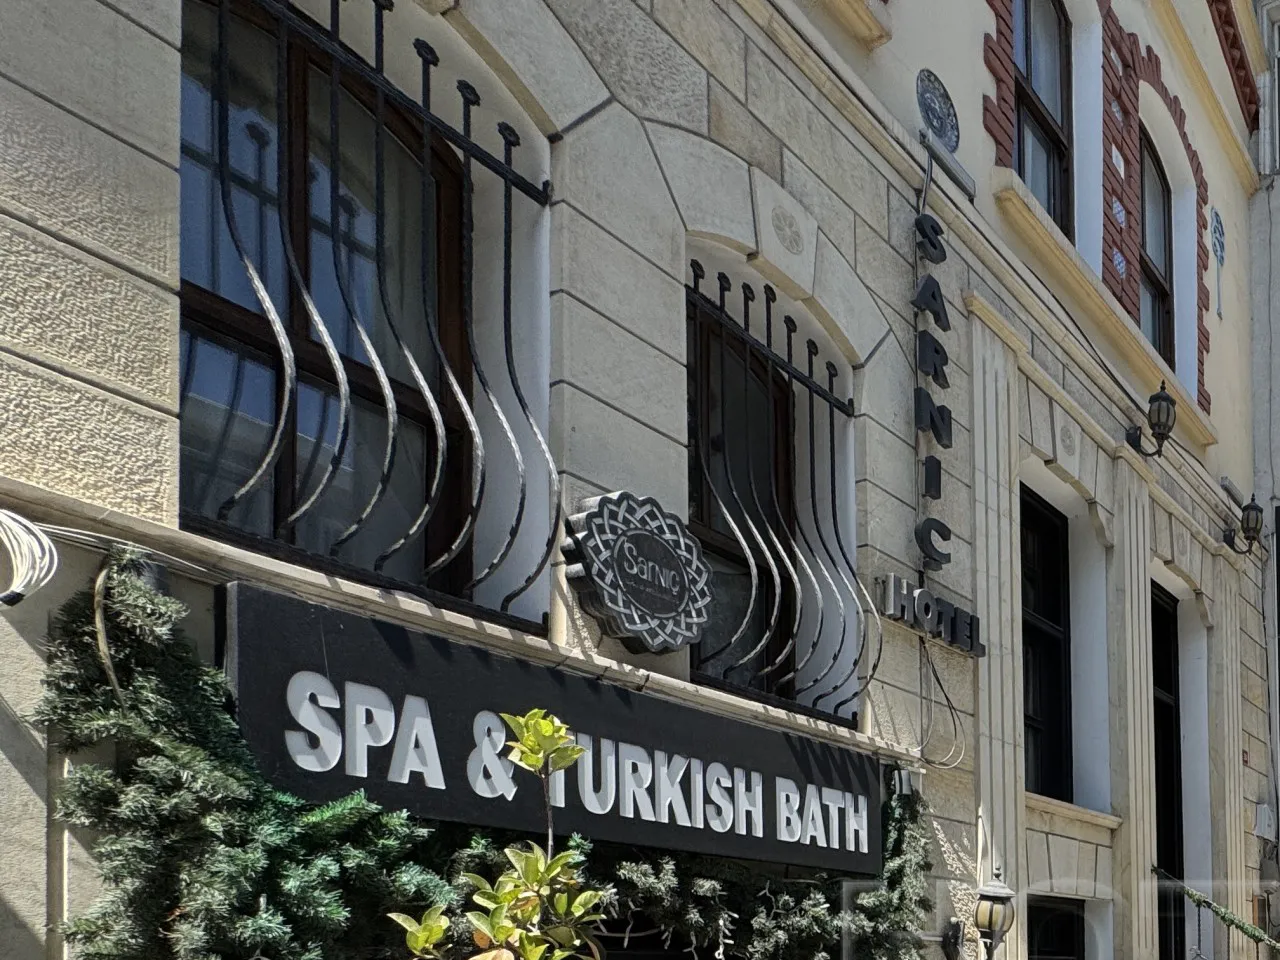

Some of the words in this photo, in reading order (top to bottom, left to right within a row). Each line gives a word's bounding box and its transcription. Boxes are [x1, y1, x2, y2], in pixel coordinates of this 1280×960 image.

[884, 572, 986, 658] HOTEL
[284, 671, 446, 790] SPA
[466, 709, 518, 802] &
[776, 777, 869, 854] BATH
